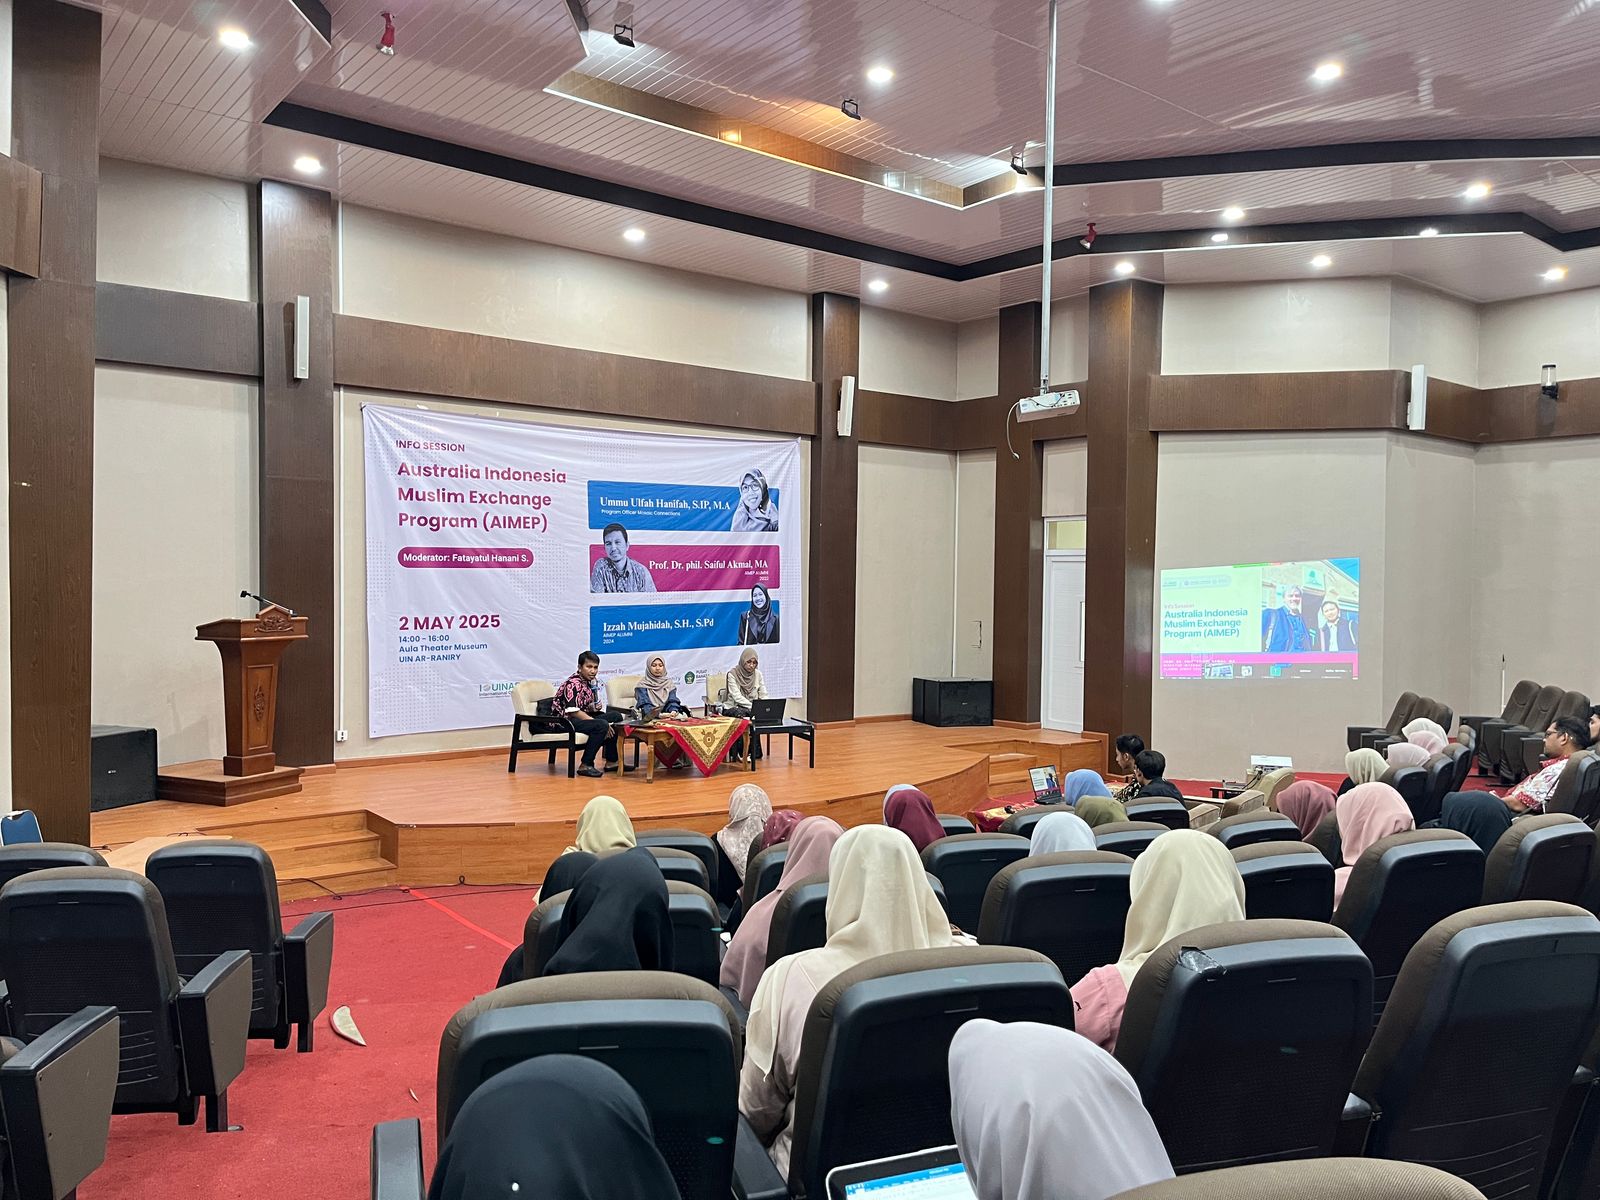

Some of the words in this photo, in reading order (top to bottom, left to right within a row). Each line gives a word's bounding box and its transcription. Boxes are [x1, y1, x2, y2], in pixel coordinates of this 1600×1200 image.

[396, 440, 420, 449] INFO
[423, 442, 465, 452] SESSION
[398, 462, 480, 480] Australia
[484, 466, 567, 483] Indonesia
[398, 487, 465, 504] Muslim
[469, 490, 552, 510] Exchange
[600, 496, 628, 507] Ummu
[630, 498, 654, 508] Ulfah
[656, 499, 690, 509] Hanifah,
[692, 500, 711, 511] S.IP,
[713, 501, 730, 510] M.A
[398, 513, 478, 532] Program
[483, 512, 548, 532] (AIMEP)
[403, 553, 450, 562] Moderator:
[452, 554, 490, 564] Fatayatul
[492, 554, 520, 562] Hanani
[521, 554, 529, 562] S.
[649, 560, 669, 569] Prof.
[671, 560, 684, 569] Dr.
[686, 560, 702, 571] phil.
[704, 560, 725, 569] Saiful
[727, 560, 752, 569] Akmal,
[754, 560, 768, 568] MA
[1165, 610, 1203, 619] Australia
[1204, 608, 1248, 617] Indonesia
[399, 616, 409, 630] 2
[414, 616, 454, 630] MAY
[459, 614, 500, 628] 2025
[603, 622, 625, 632] Izzah
[628, 620, 672, 632] Mujahidah,
[674, 619, 694, 628] S.H.,
[696, 618, 714, 628] S.Pd
[1164, 619, 1195, 628] Muslim
[1198, 619, 1241, 628] Exchange
[1164, 630, 1201, 639] Program
[1204, 628, 1240, 638] (AIMEP)
